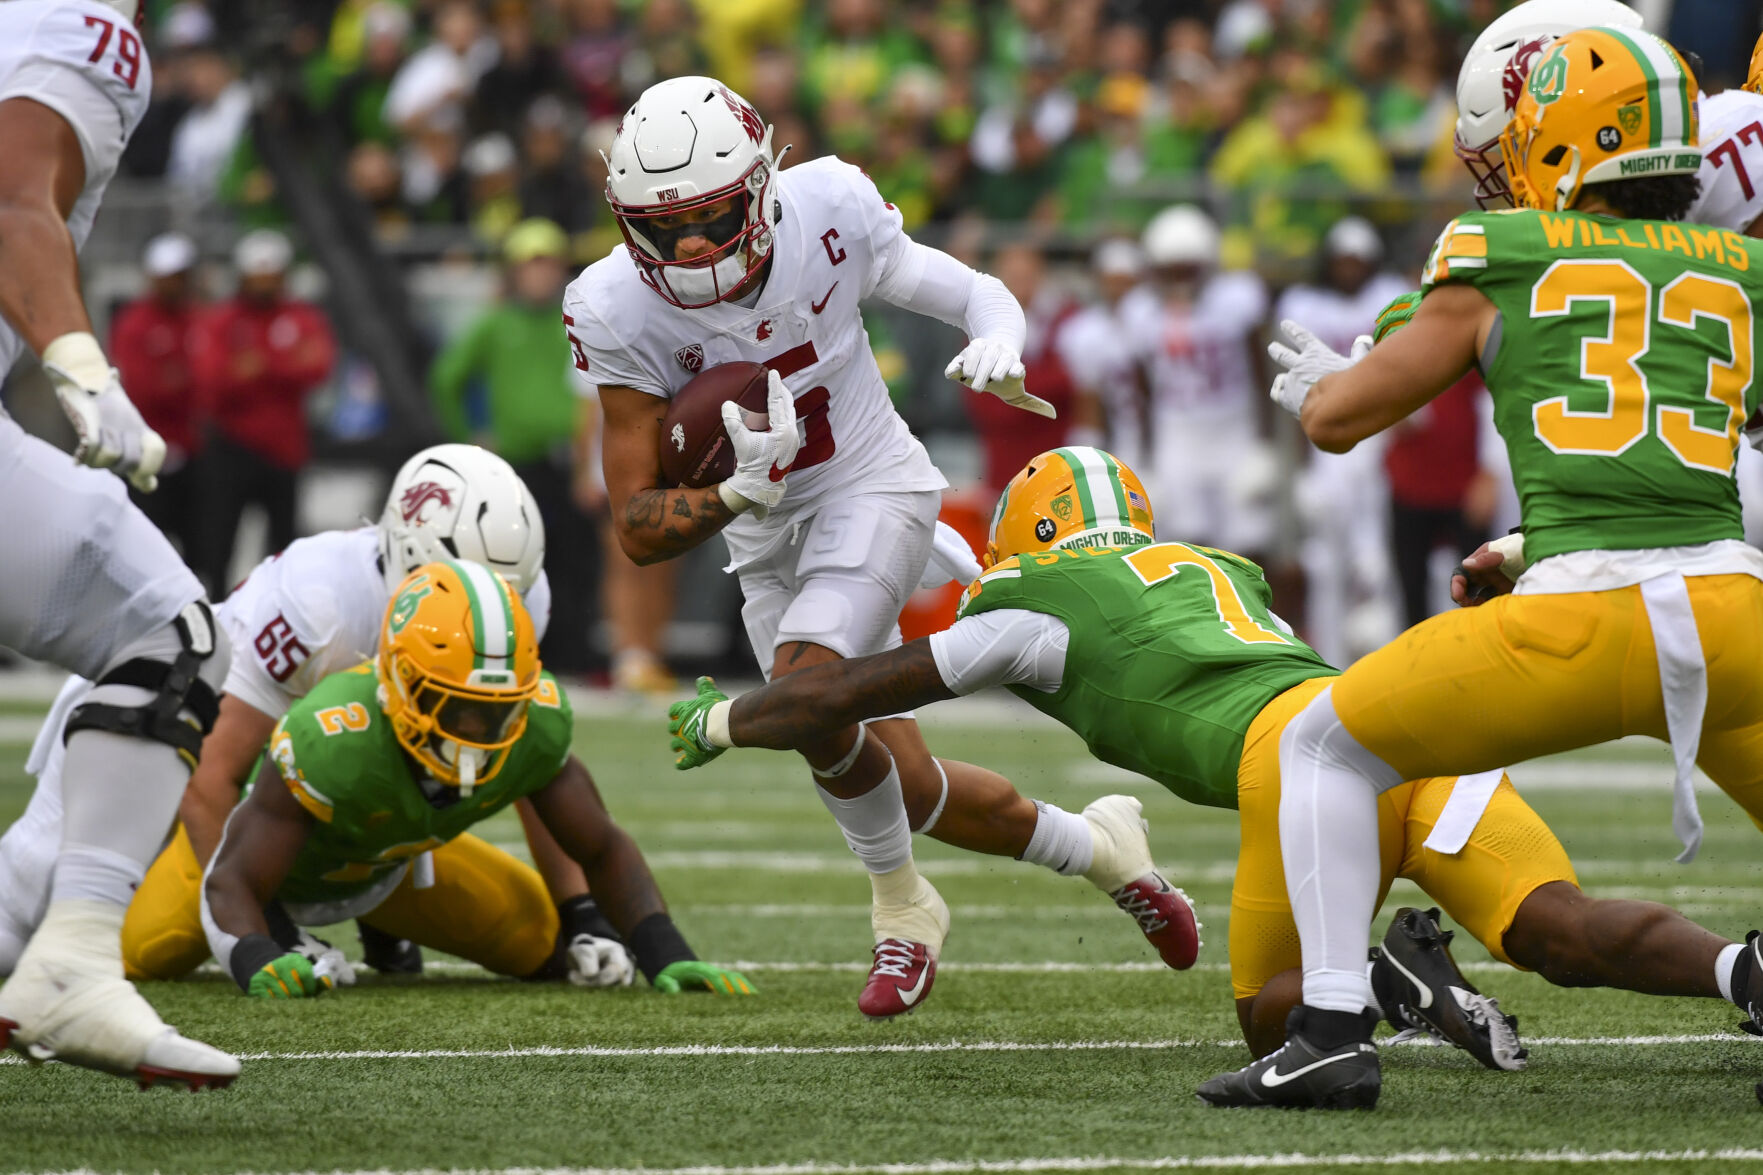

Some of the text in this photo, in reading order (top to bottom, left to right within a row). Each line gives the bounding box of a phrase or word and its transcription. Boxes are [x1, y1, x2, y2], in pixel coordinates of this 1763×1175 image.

[84, 15, 140, 91] 79
[1600, 129, 1619, 145] 64
[1619, 154, 1671, 175] MIGHTY
[656, 187, 679, 202] WSU
[820, 228, 847, 266] C
[1538, 213, 1749, 272] WILLIAMS
[1529, 258, 1754, 478] 33
[1037, 520, 1054, 537] 64
[1121, 542, 1295, 645] 7
[253, 611, 311, 684] 65
[314, 701, 371, 737] 2
